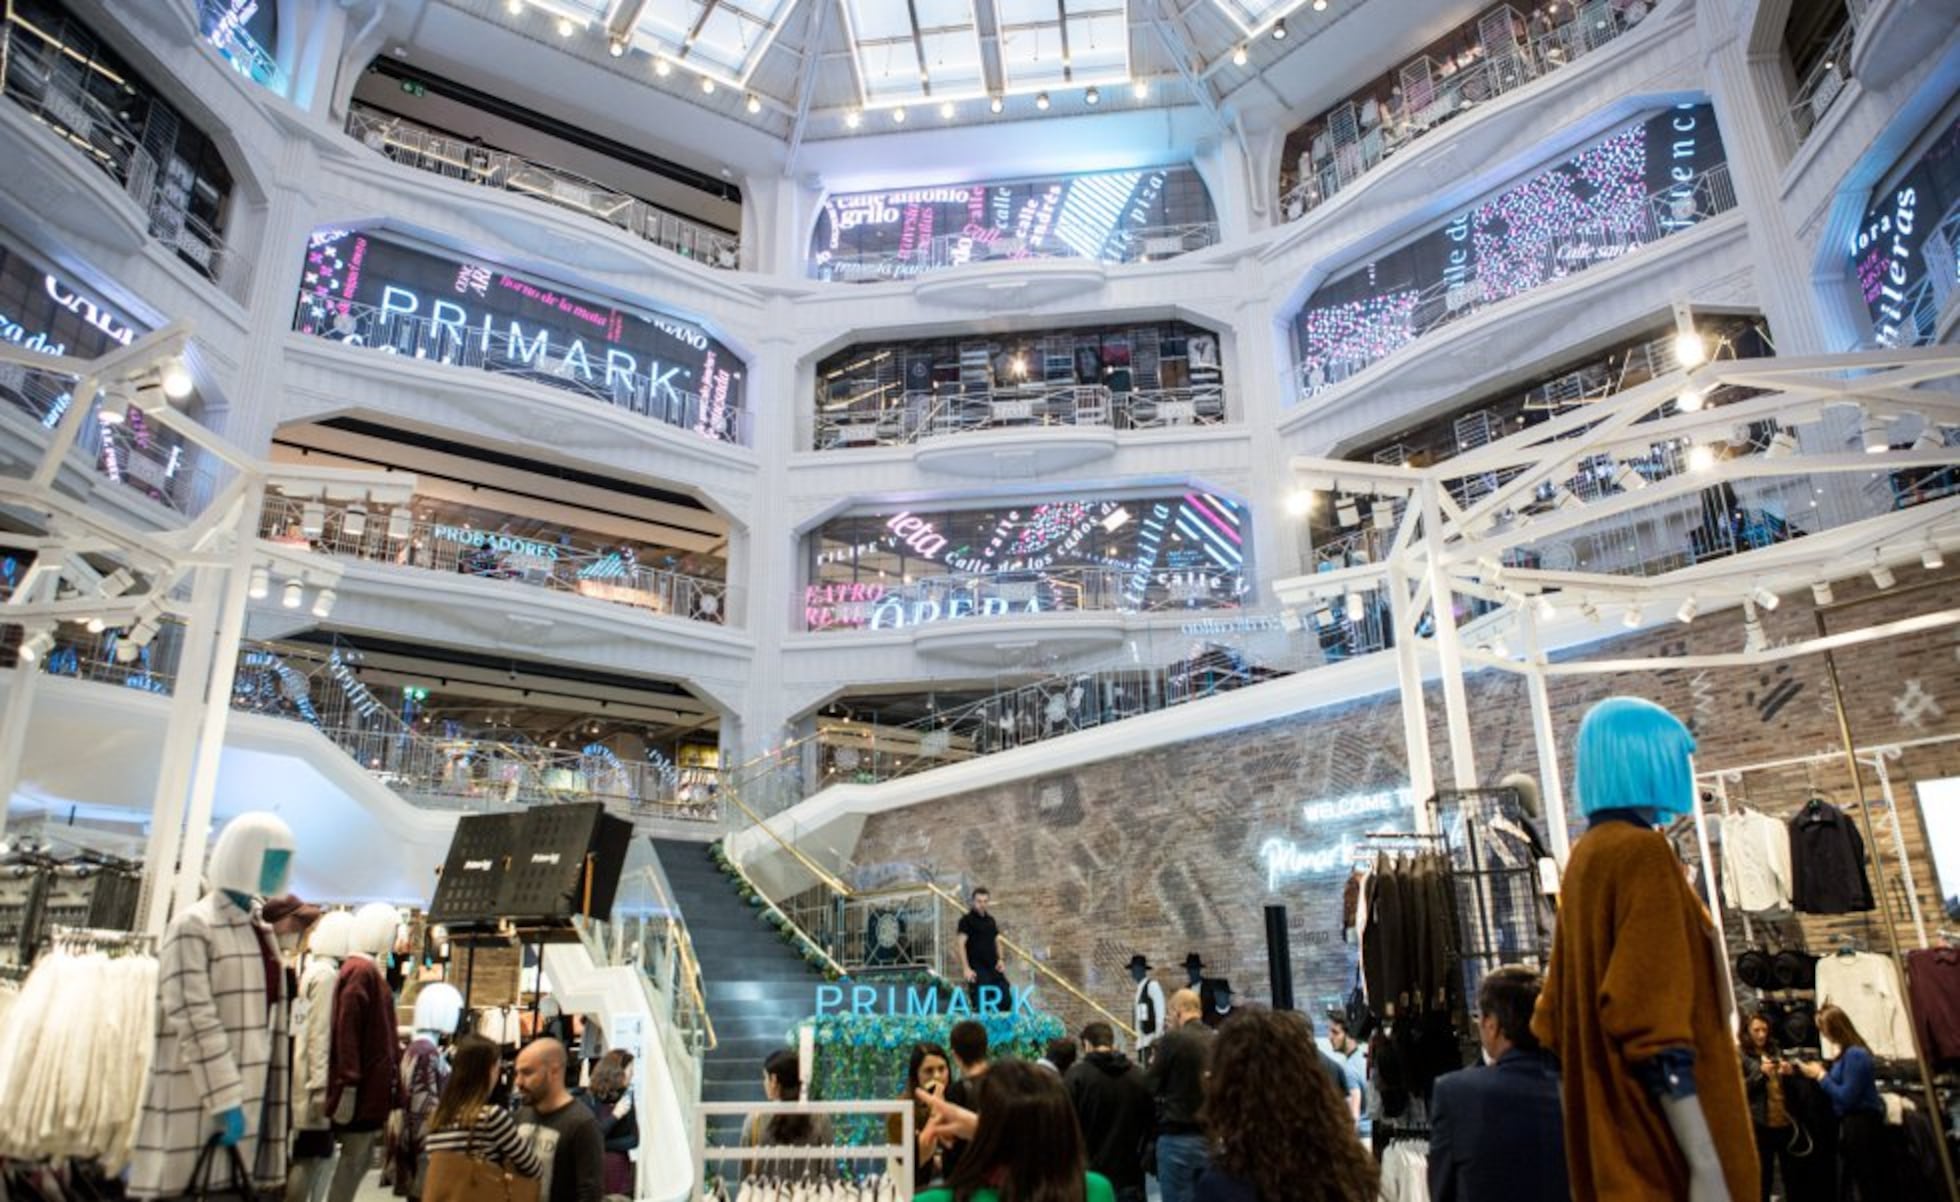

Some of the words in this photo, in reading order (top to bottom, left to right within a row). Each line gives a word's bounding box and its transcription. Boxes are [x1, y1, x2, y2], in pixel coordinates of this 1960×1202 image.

[887, 188, 970, 204] antonio
[838, 205, 899, 230] grillo
[1015, 198, 1039, 239] calle
[379, 284, 682, 404] PRIMARK
[434, 523, 559, 562] PROBADORES
[1028, 551, 1053, 570] los
[1157, 570, 1222, 590] calle
[1303, 792, 1393, 823] WELCOME
[815, 984, 1036, 1017] PRIMARK
